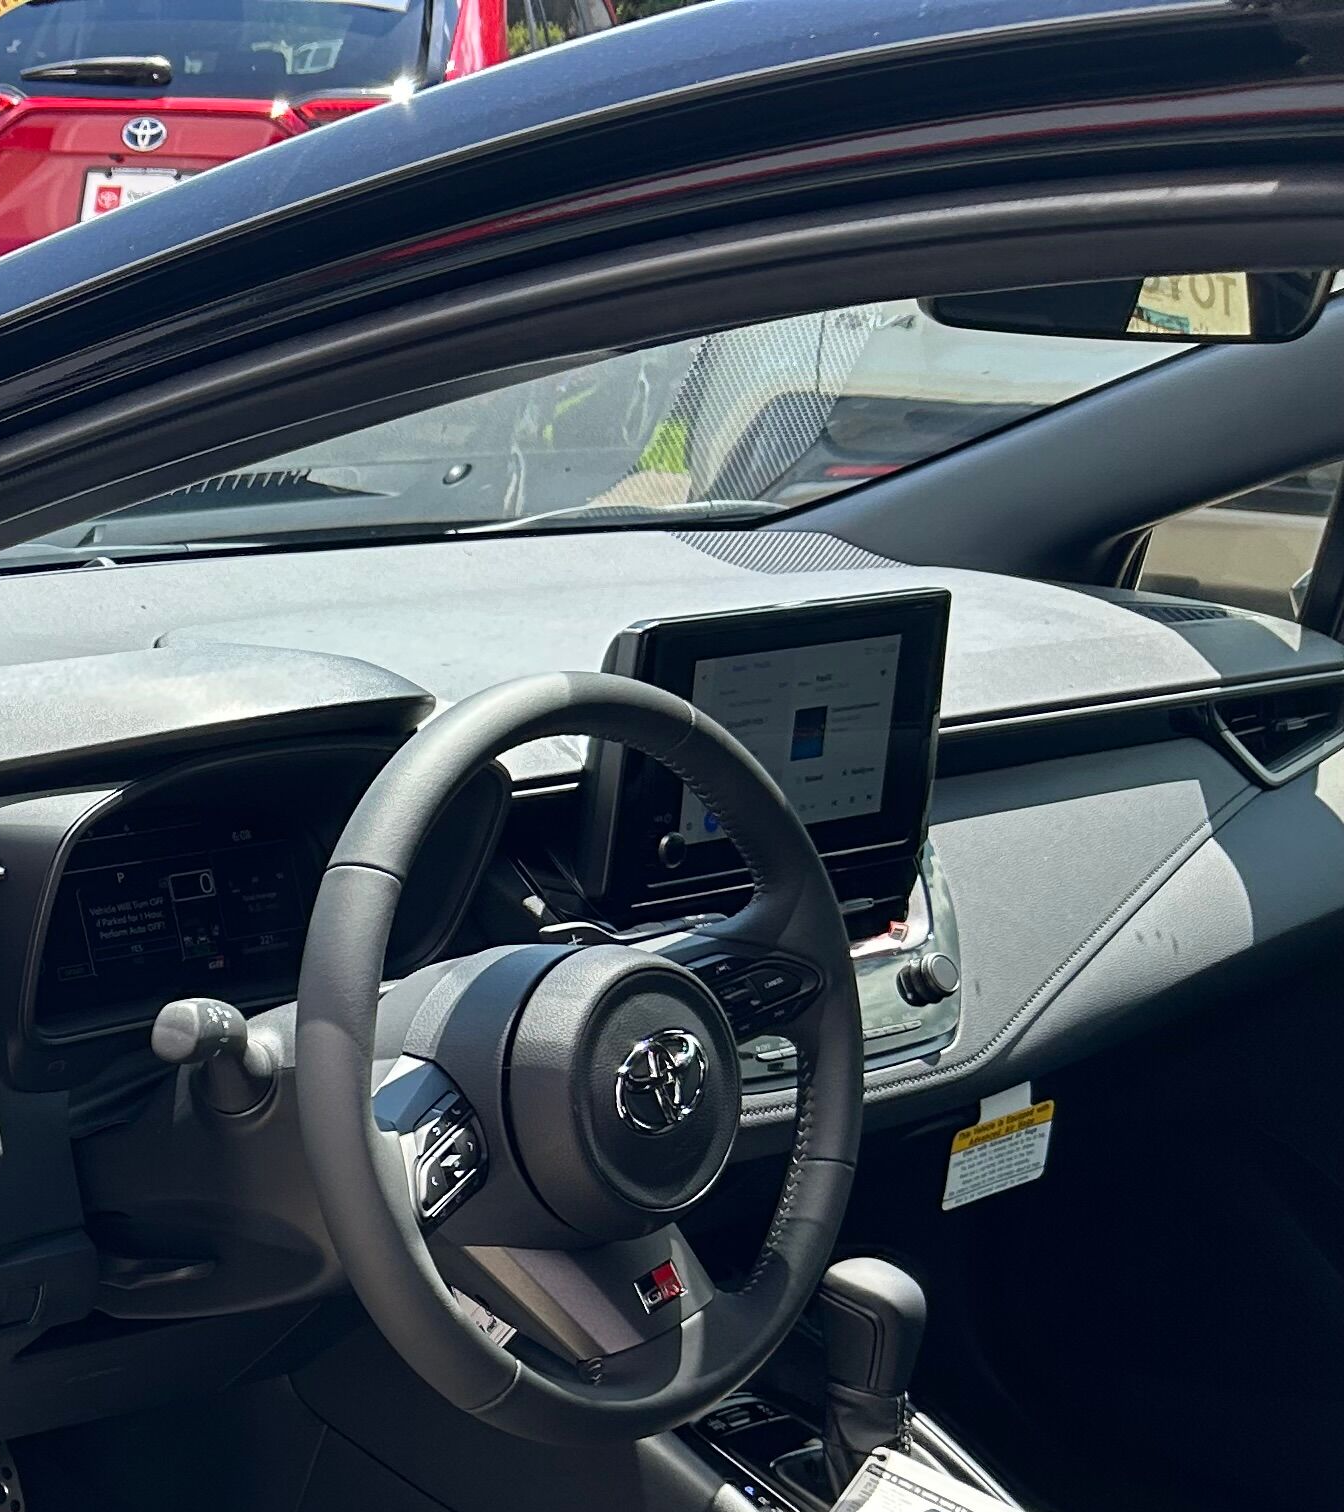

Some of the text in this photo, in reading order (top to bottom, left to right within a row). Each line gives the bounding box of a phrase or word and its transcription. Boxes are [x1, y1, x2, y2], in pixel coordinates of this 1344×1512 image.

[117, 873, 125, 883] P
[200, 873, 212, 893] 0
[102, 915, 127, 927] Parked
